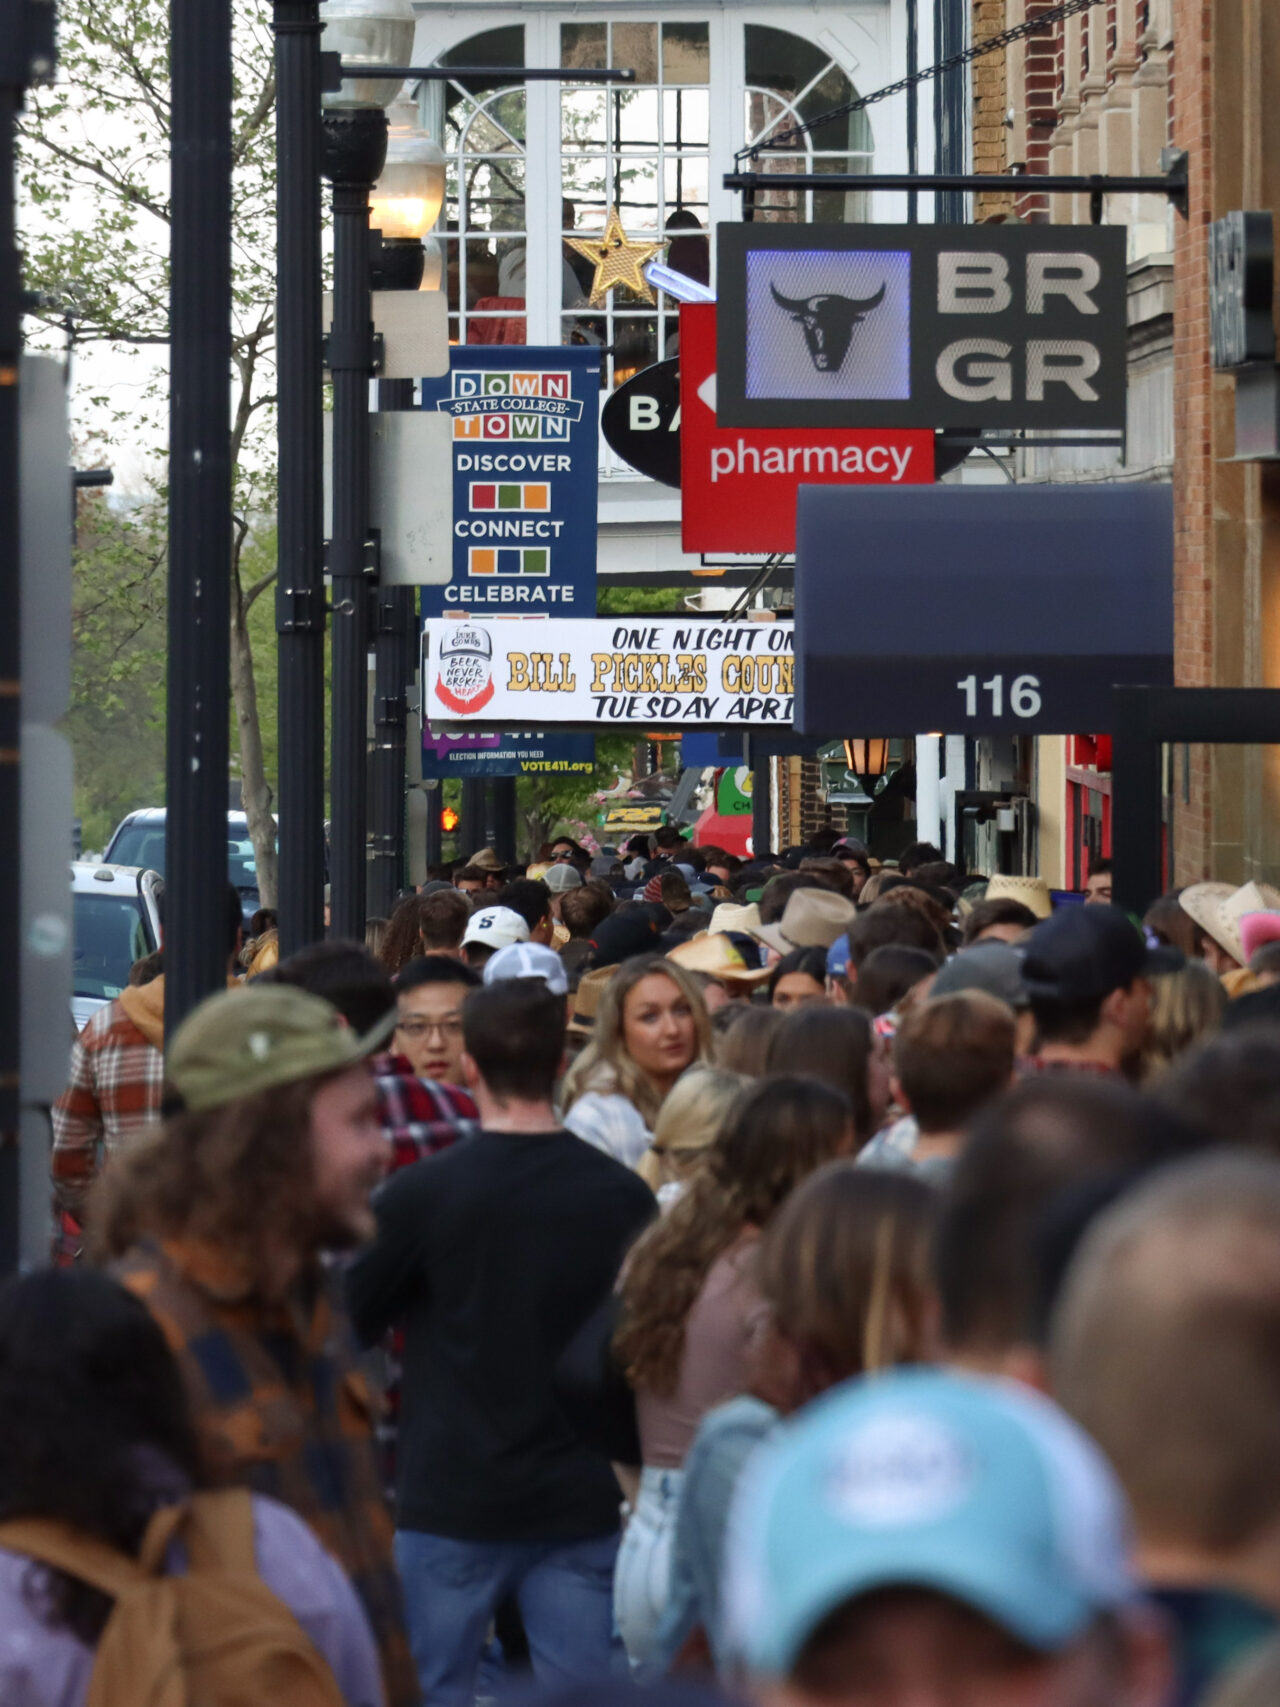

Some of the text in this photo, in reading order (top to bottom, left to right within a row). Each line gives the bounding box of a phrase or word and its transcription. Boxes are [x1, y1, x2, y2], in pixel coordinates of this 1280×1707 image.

[936, 252, 1101, 314] BR
[935, 338, 1101, 402] GR
[460, 378, 564, 397] DOWN
[459, 416, 563, 435] TOWN
[457, 454, 572, 473] DISCOVER
[711, 438, 912, 483] pharmacy
[454, 520, 565, 538] CONNECT
[444, 585, 575, 603] CELEBRATE
[612, 627, 664, 650] ONE
[673, 627, 767, 651] NIGHT
[446, 667, 484, 678] NEVER
[506, 652, 576, 692] BILL
[590, 653, 708, 693] PICKLES
[957, 674, 1042, 718] 116
[591, 695, 720, 719] TUESDAY
[477, 752, 516, 760] INFORMATION
[521, 761, 593, 774] VOTE411.org
[478, 915, 496, 930] S
